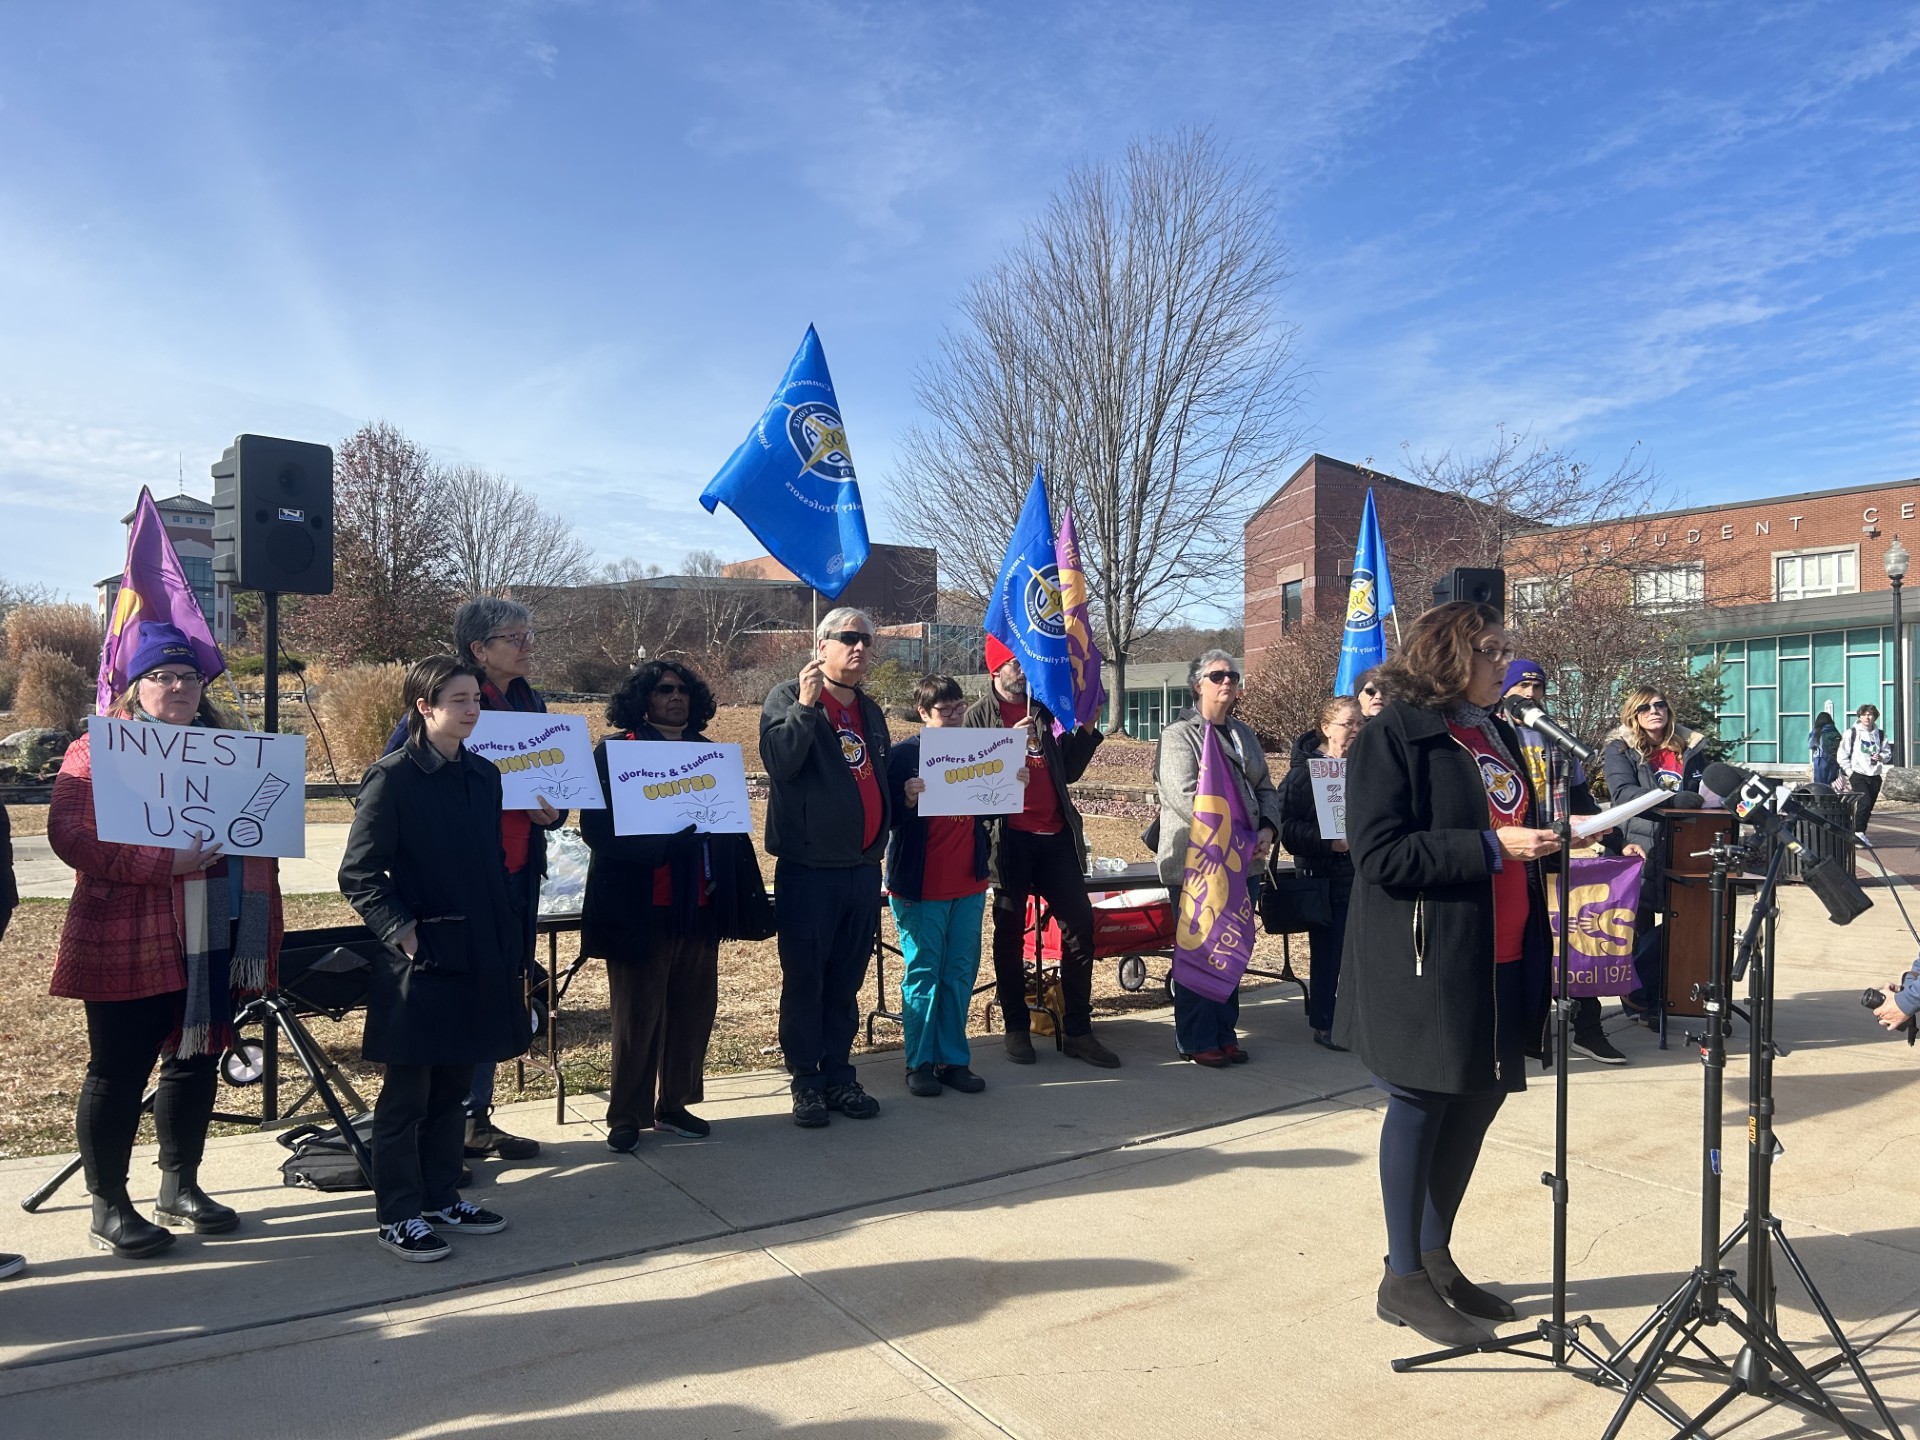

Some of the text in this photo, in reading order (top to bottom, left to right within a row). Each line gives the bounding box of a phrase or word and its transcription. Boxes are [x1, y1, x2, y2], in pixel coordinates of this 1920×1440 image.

[1601, 503, 1916, 553] STUDENT CE
[1062, 539, 1080, 567] THE
[1003, 553, 1026, 592] American
[1002, 594, 1021, 639] Association
[1028, 601, 1060, 634] FOR FACULTY
[1024, 644, 1060, 665] University
[108, 722, 275, 769] INVEST
[468, 723, 571, 754] Workers & Students
[926, 736, 1014, 768] Workers & Students
[493, 747, 566, 774] UNITED
[618, 750, 725, 783] Workers & Students
[944, 758, 1005, 784] UNITED
[160, 772, 209, 803] IN
[643, 773, 717, 800] UNITED
[1740, 774, 1771, 804] CT
[1554, 964, 1632, 984] Local 1973
